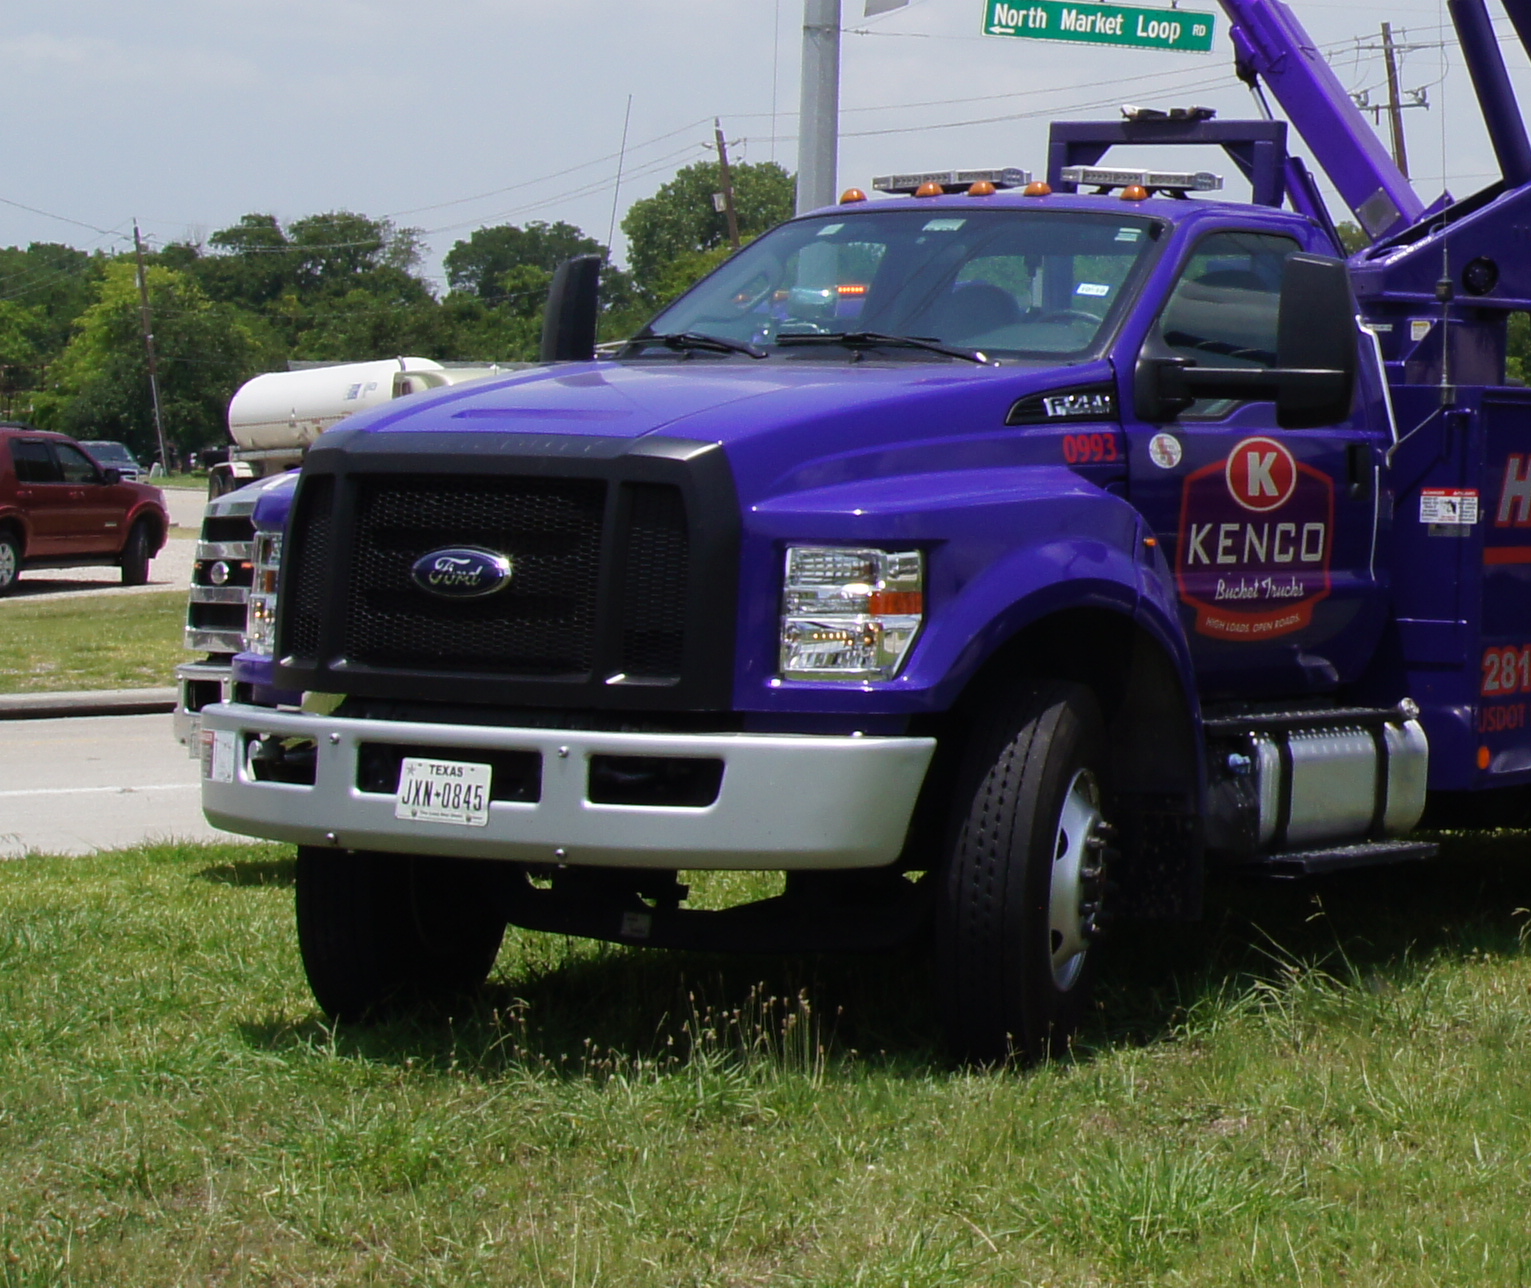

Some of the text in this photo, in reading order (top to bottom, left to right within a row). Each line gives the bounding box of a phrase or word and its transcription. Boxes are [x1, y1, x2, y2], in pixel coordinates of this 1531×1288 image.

[993, 3, 1206, 44] North Market Loop RD
[1063, 433, 1117, 463] 0993
[1247, 451, 1279, 497] K
[1188, 522, 1325, 564] KENCO
[429, 556, 483, 586] Ford
[1214, 576, 1304, 600] Bucket Trucks
[1252, 621, 1274, 633] OPEN
[429, 764, 464, 778] TEXAS
